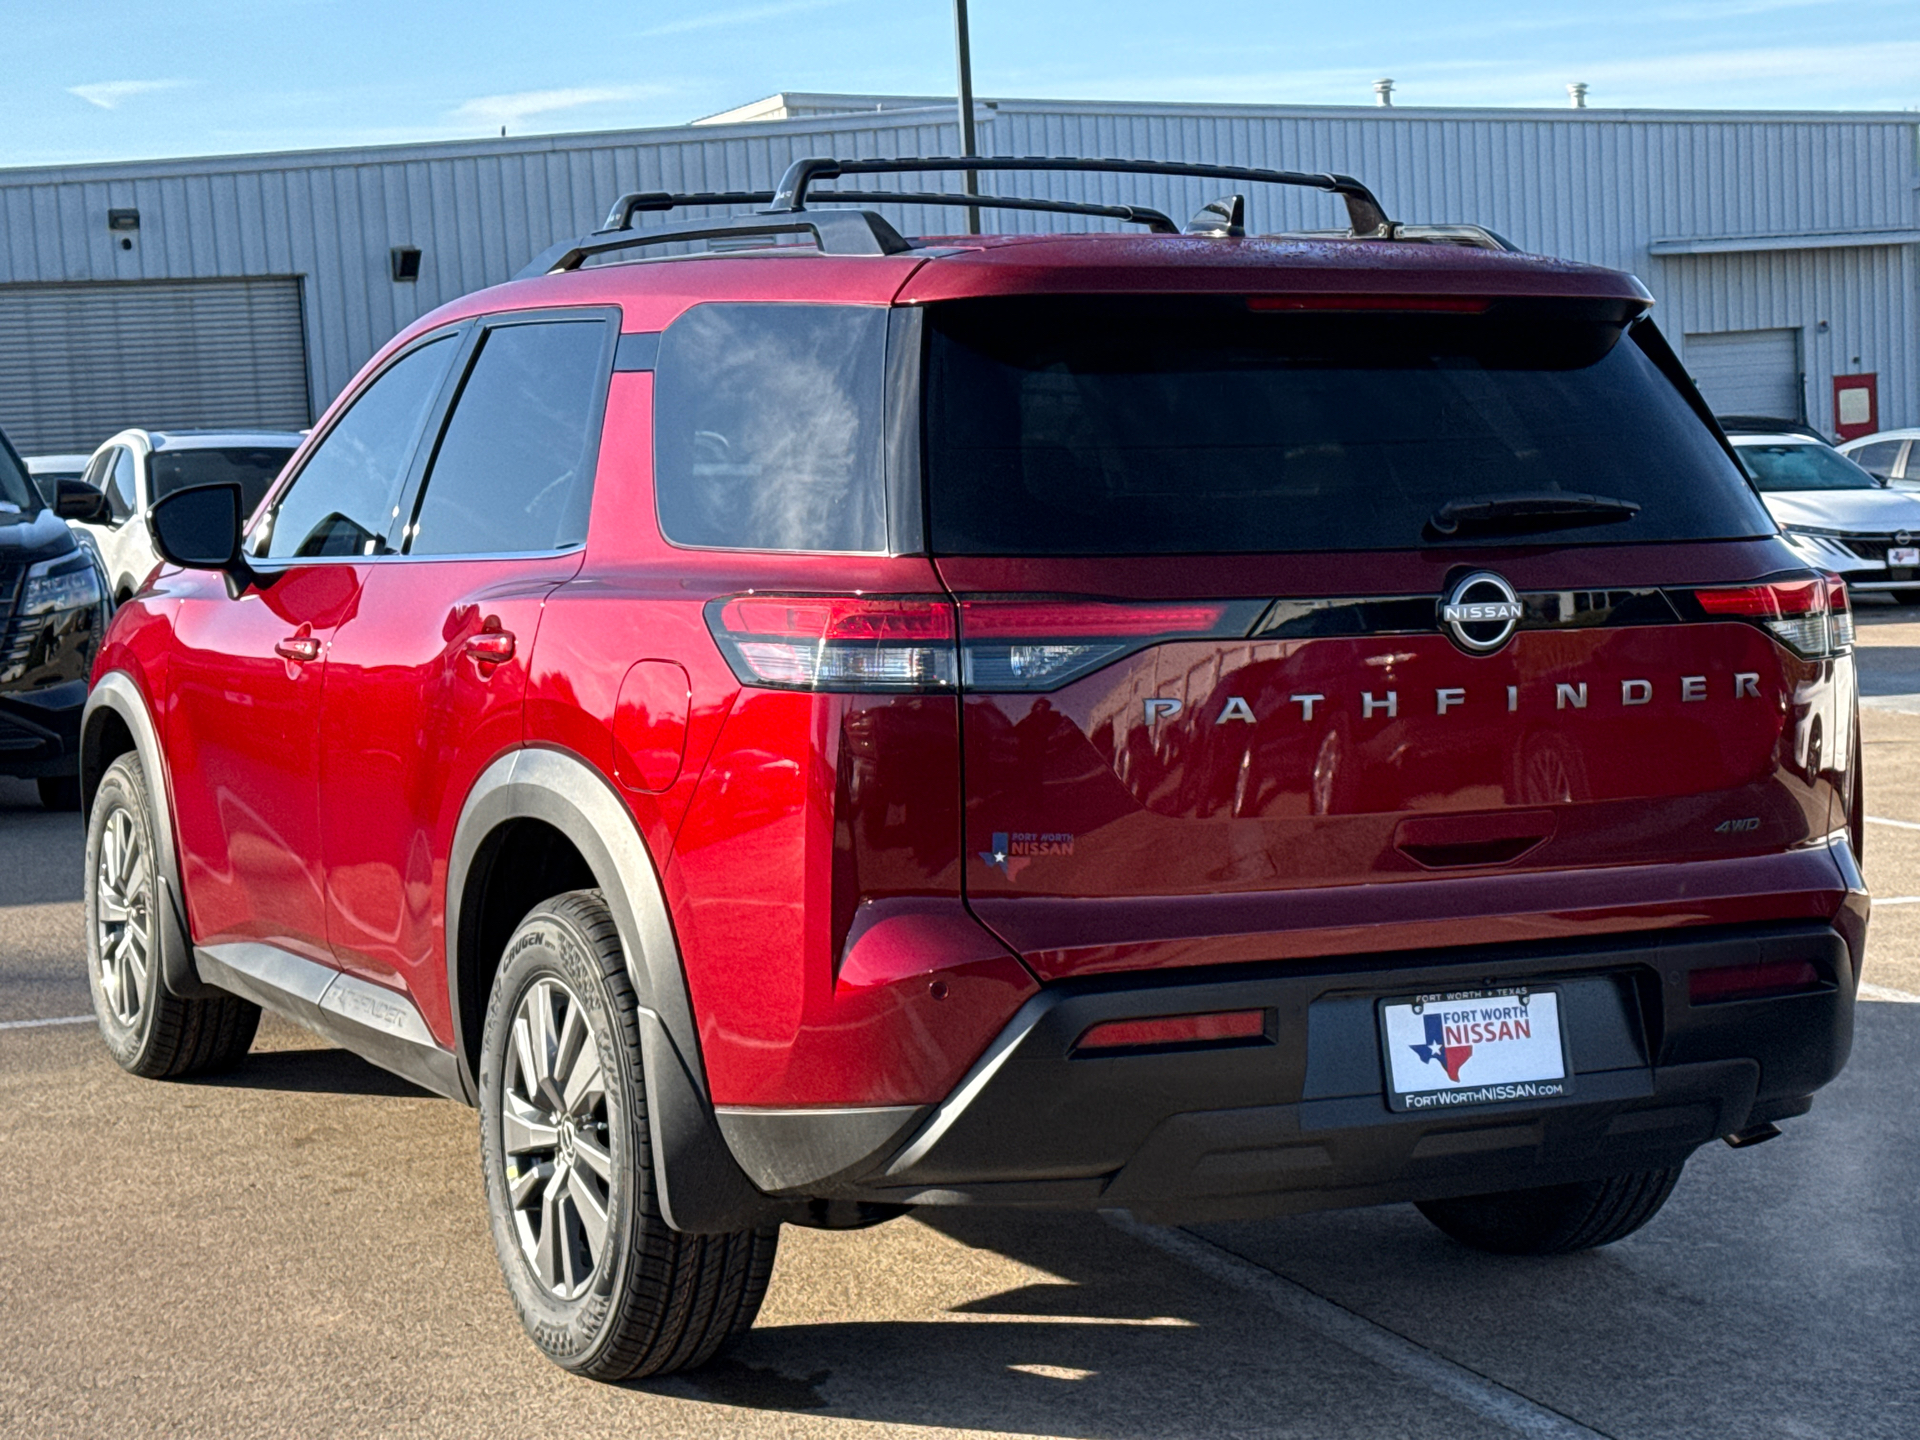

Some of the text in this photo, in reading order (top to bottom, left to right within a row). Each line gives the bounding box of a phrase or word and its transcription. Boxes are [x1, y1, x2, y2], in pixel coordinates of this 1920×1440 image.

[1446, 605, 1522, 619] NISSAN
[1143, 672, 1762, 726] PATHFINDER
[1715, 817, 1760, 832] 4WD
[1012, 833, 1037, 841] FORT
[1012, 842, 1073, 855] NISSAN
[1416, 987, 1527, 1003] FORT WORTH TEXAS
[1443, 1006, 1528, 1024] FORT WORTH
[1445, 1019, 1531, 1045] NISSAN
